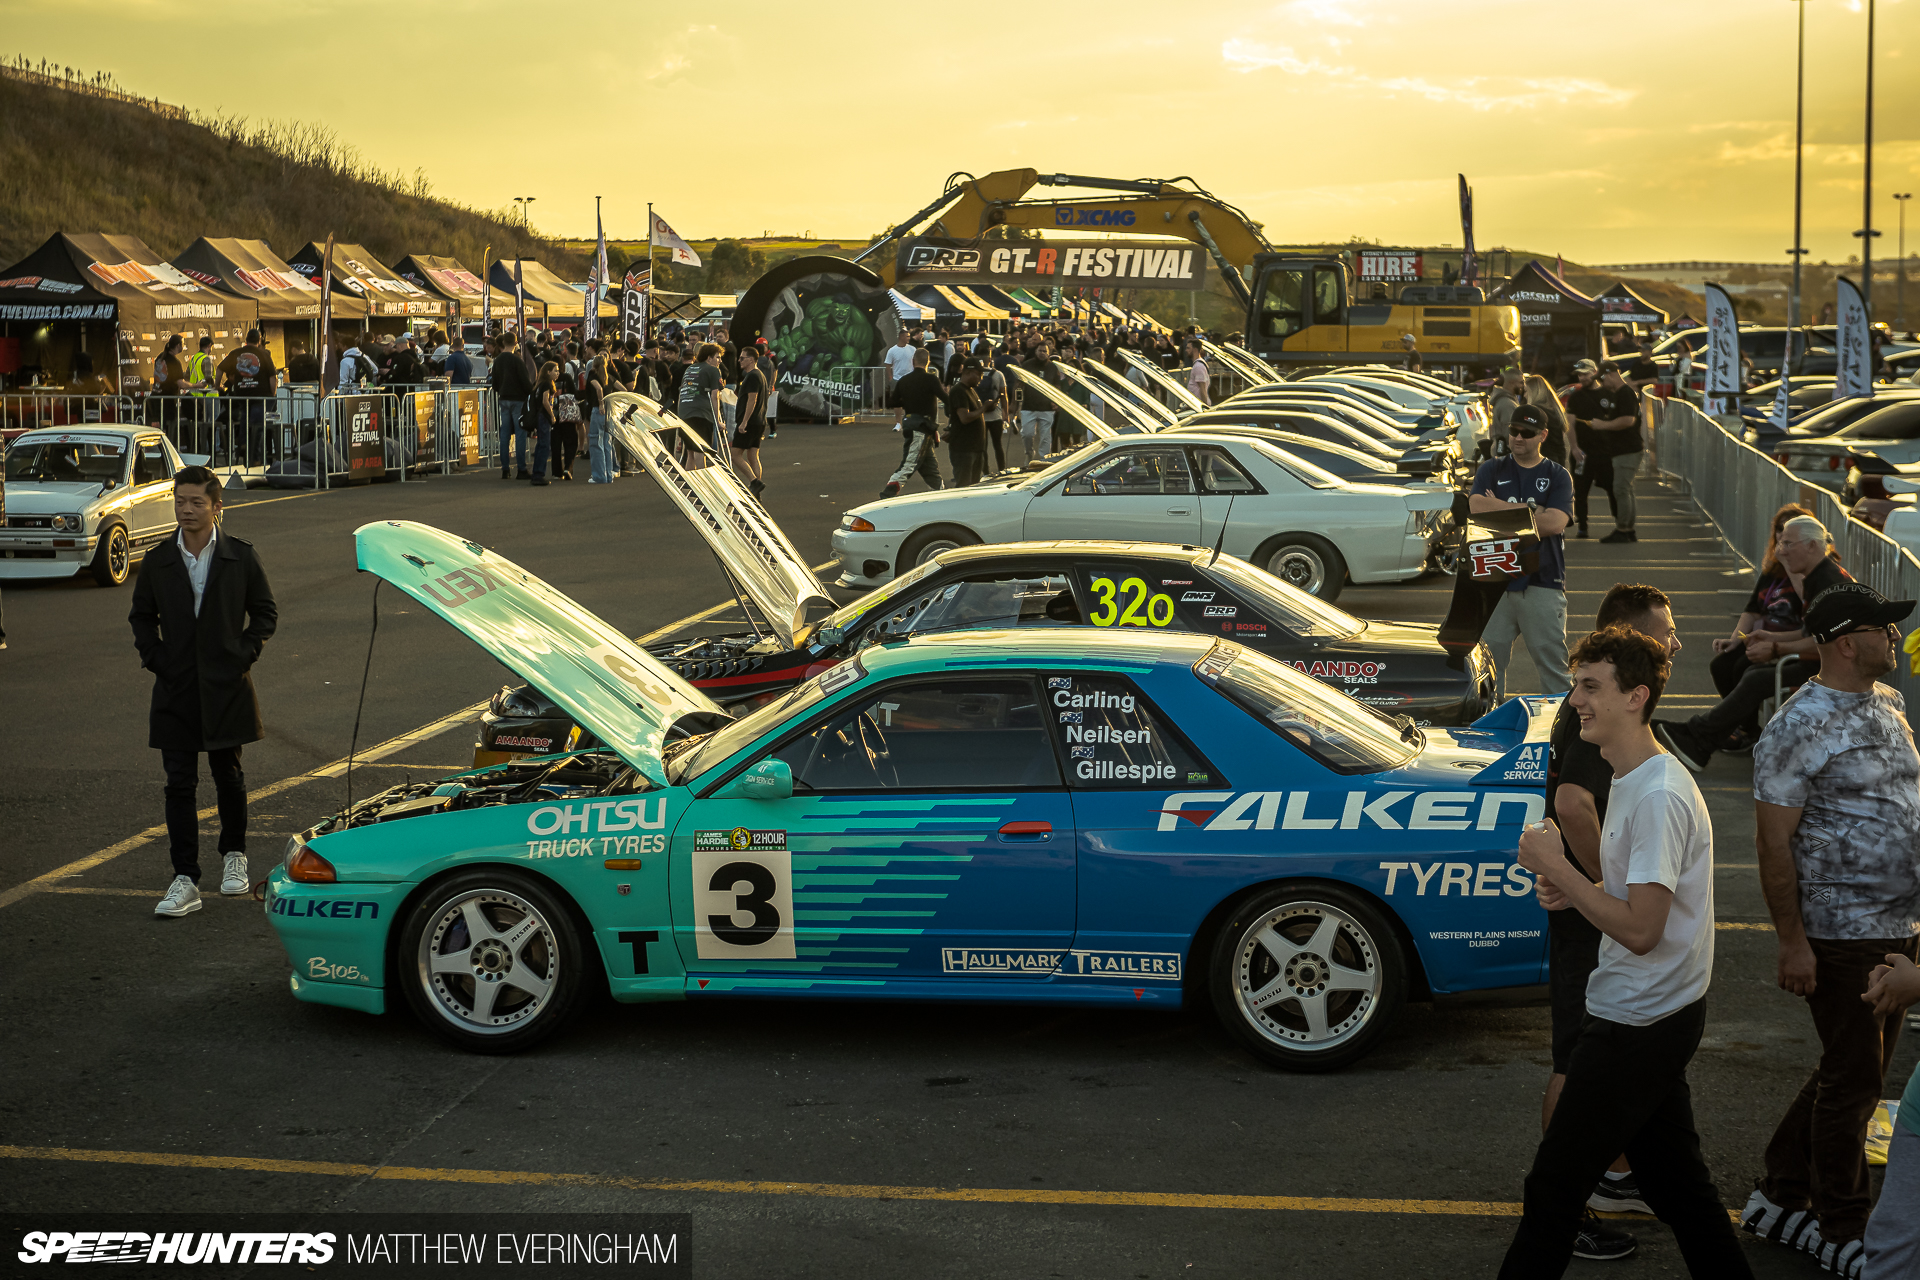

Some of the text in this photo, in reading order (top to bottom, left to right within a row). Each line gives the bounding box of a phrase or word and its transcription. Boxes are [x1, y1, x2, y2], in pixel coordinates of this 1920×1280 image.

[1077, 209, 1136, 227] XCMG
[909, 248, 1193, 278] PRP GT-R FESTIVAL
[1362, 257, 1416, 275] HIRE
[1520, 313, 1551, 323] brant
[352, 413, 378, 431] GT-R
[352, 431, 379, 443] FESTIVAL
[459, 435, 479, 448] FESTIVAL
[352, 456, 382, 469] VIP AREA
[1469, 538, 1520, 555] GT
[1471, 551, 1522, 577] R
[1237, 623, 1267, 631] BOSCH
[1829, 619, 1852, 633] NAUTICA
[1053, 690, 1135, 713] Carling
[495, 736, 549, 746] AMAANDO
[1066, 726, 1150, 743] Neilsen
[1518, 746, 1543, 760] A1
[1076, 761, 1177, 783] Gillespie
[1514, 761, 1540, 770] SIGN
[1503, 770, 1545, 779] SERVICE
[527, 798, 668, 835] OHTSU
[1157, 791, 1546, 831] FALKEN
[527, 834, 665, 859] TRUCK TYRES
[696, 833, 785, 845] HARDIE 12 HOUR
[1379, 862, 1534, 896] TYRES
[708, 861, 781, 946] 3
[1508, 930, 1541, 938] NISSAN
[618, 930, 659, 974] T
[1469, 940, 1500, 948] DUBBO
[307, 956, 360, 979] B105
[947, 951, 1177, 974] HAULMARK TRAILERS
